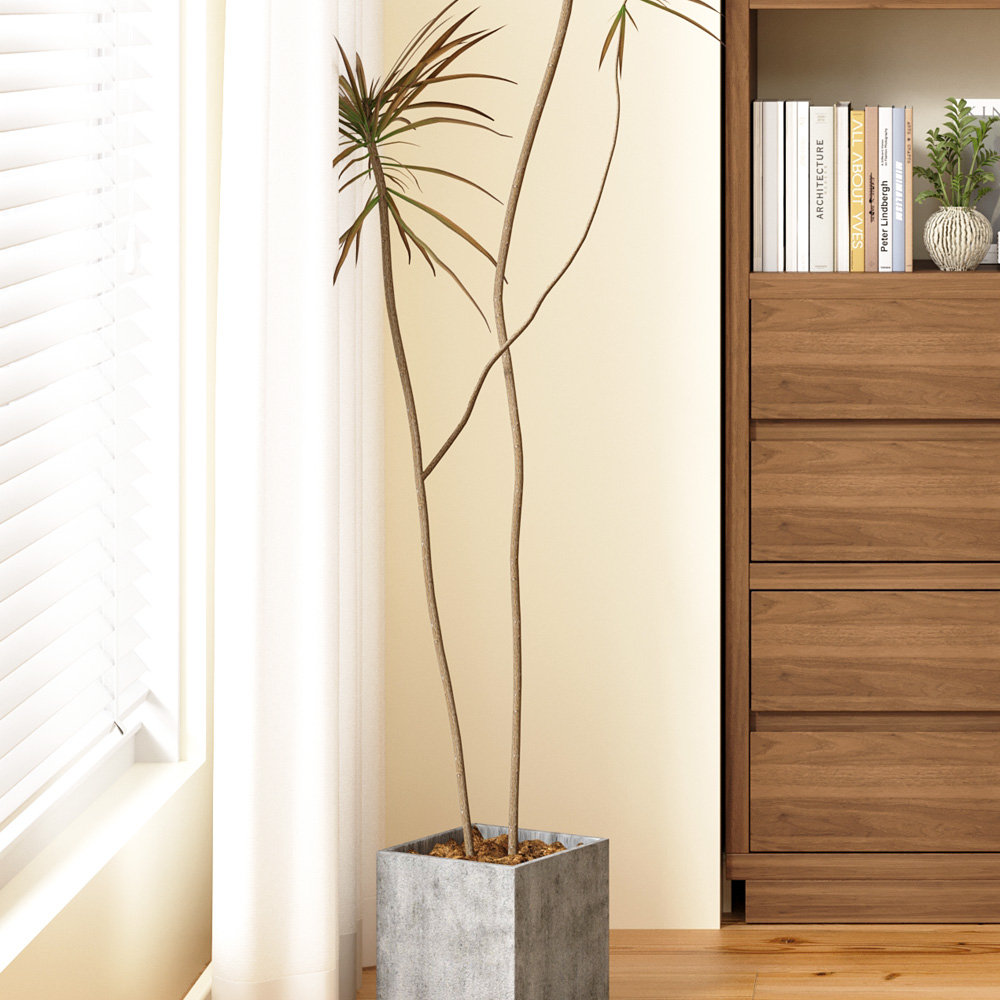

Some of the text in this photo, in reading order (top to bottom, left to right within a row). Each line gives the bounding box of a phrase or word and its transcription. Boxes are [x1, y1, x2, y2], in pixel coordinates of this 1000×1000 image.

[816, 139, 824, 220] ARCHITECTURE
[852, 119, 864, 249] ALL ABOUT YVES
[880, 180, 890, 252] Peter Lindbergh
[895, 160, 903, 221] MINIMALISM
